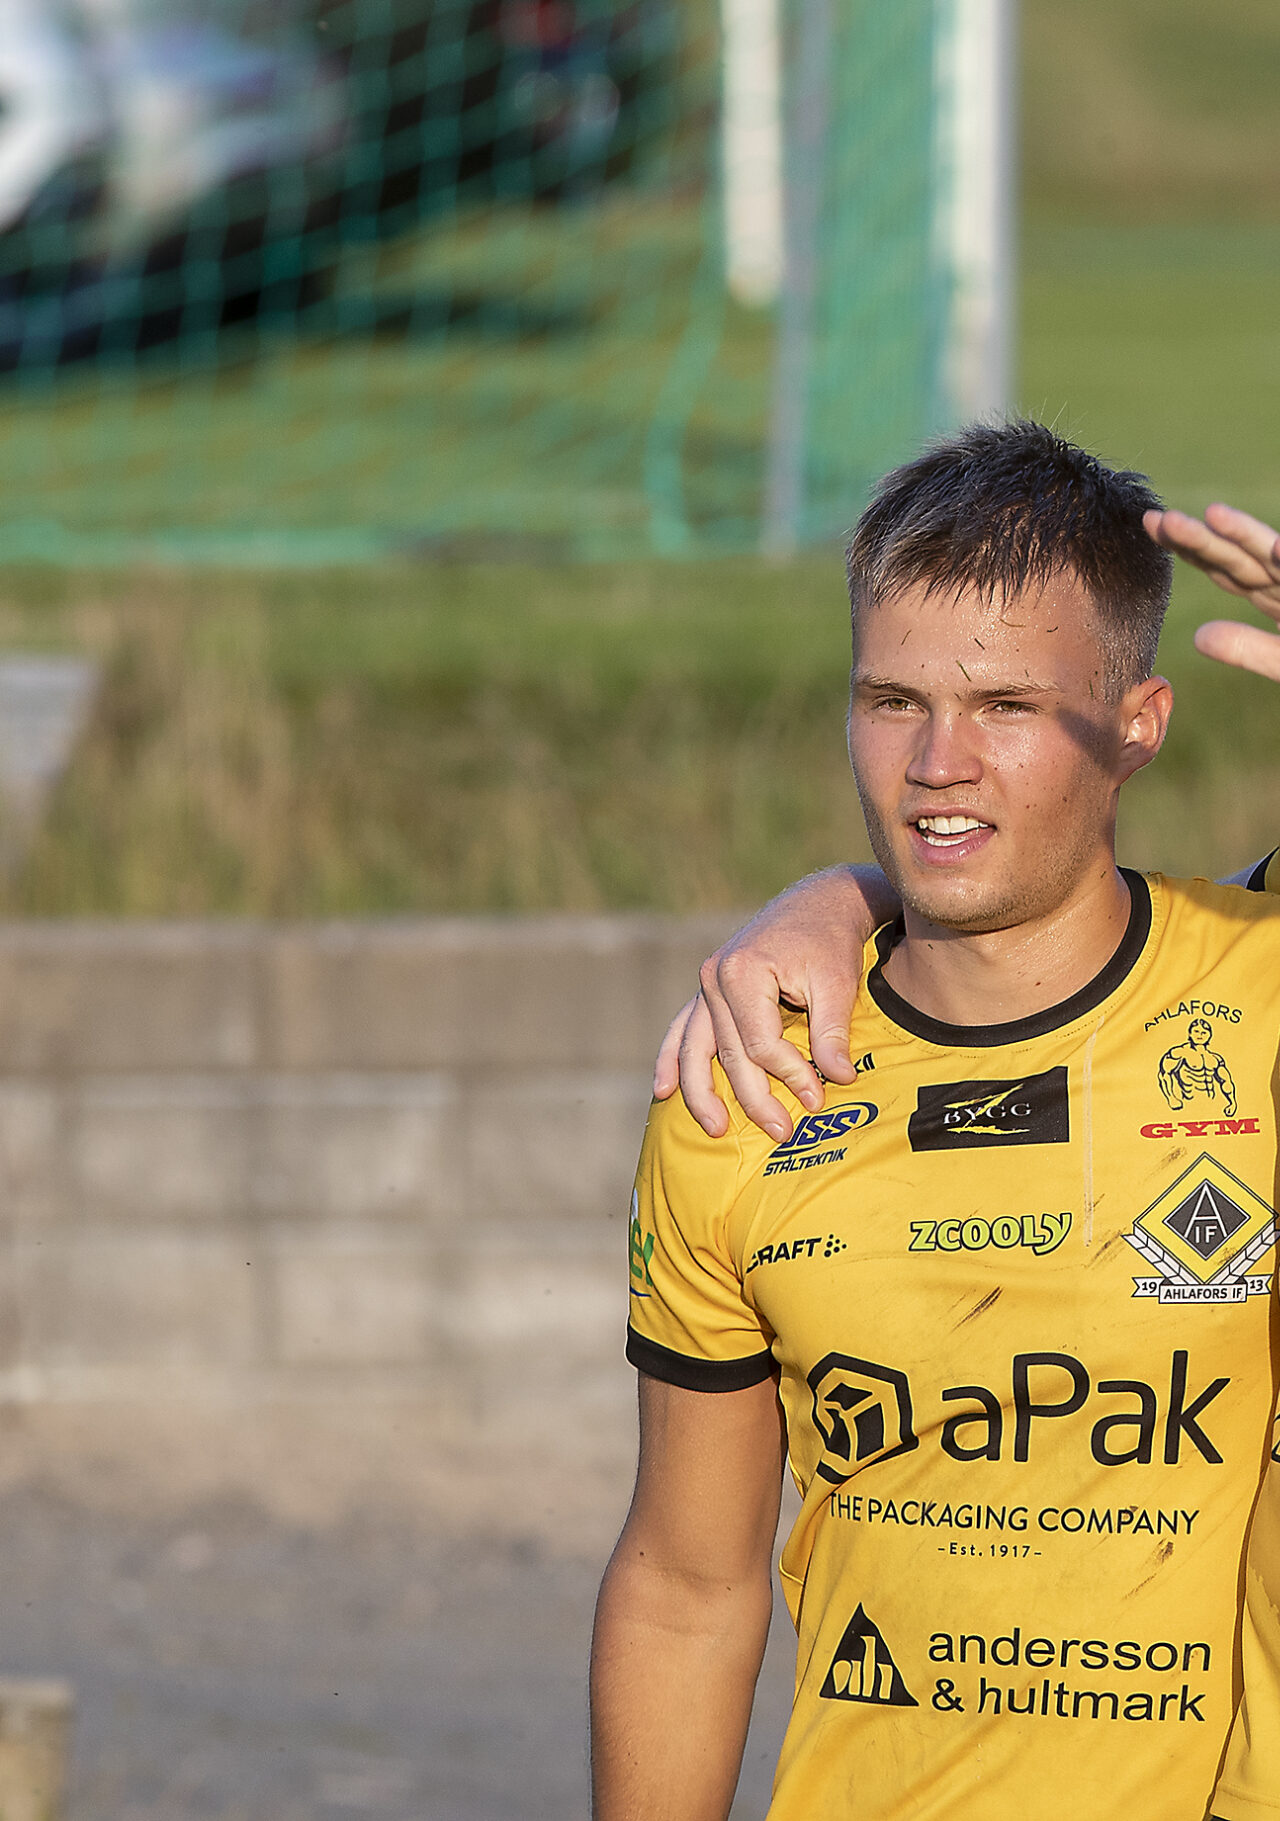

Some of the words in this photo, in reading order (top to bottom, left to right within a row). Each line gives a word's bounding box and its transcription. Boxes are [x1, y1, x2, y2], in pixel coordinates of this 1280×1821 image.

[1144, 1000, 1243, 1032] AHLAFORS
[943, 1103, 1032, 1124] BYGG
[1140, 1118, 1261, 1139] GYM
[762, 1147, 848, 1177] STÅLTEKNIK
[1141, 1281, 1157, 1294] 19
[1163, 1286, 1228, 1300] AHLAFORS
[1232, 1287, 1243, 1299] IF
[1249, 1279, 1264, 1291] 13
[941, 1350, 1231, 1466] aPak
[830, 1492, 863, 1521] THE
[867, 1499, 1029, 1532] PACKAGING
[1037, 1506, 1200, 1536] COMPANY
[928, 1627, 1212, 1672] andersson
[931, 1677, 965, 1714] &
[977, 1677, 1207, 1722] hultmark
